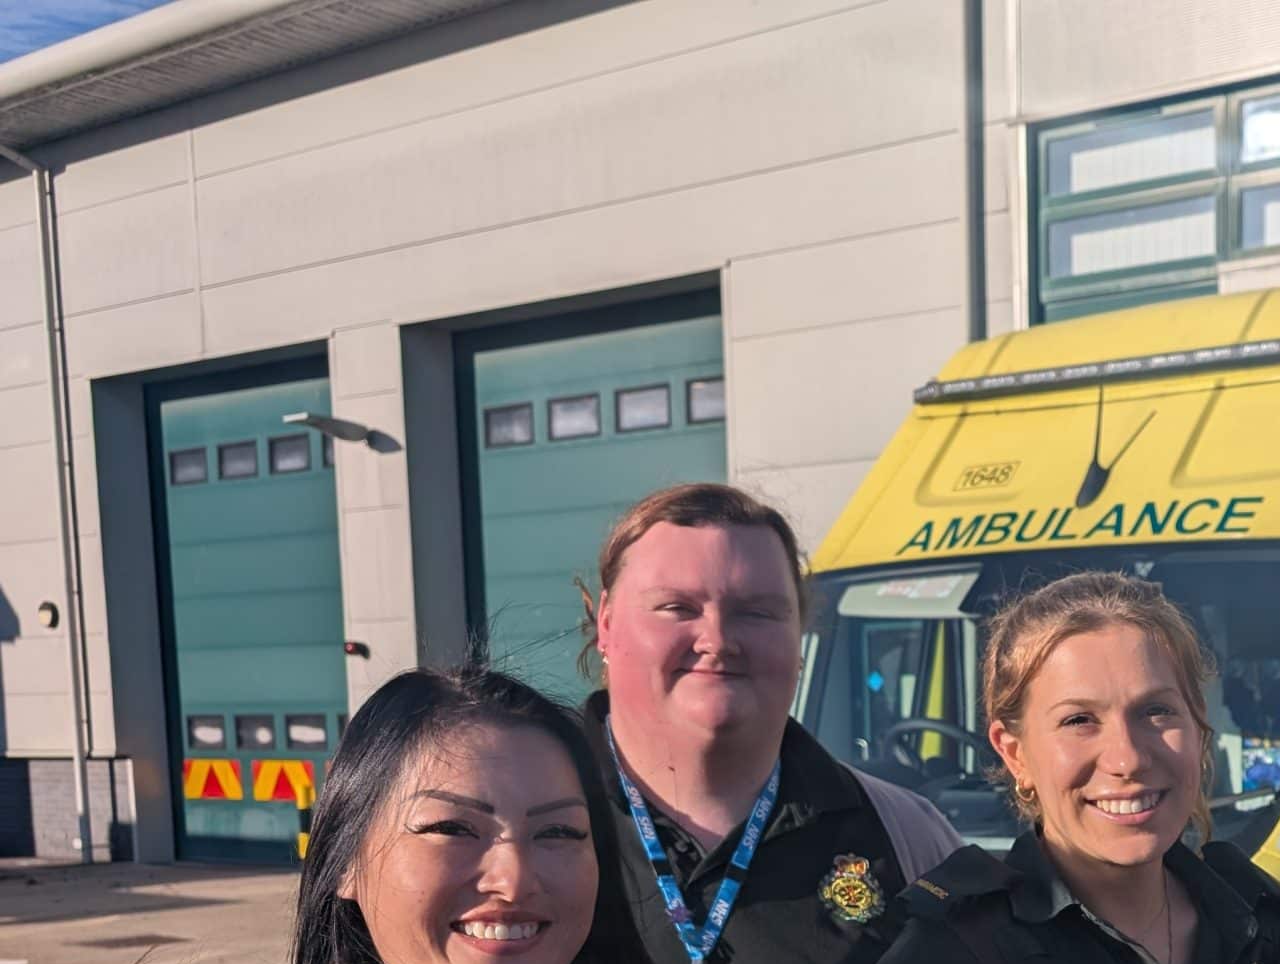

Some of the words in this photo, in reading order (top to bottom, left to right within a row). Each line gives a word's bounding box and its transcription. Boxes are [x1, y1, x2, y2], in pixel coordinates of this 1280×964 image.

[961, 464, 1013, 487] 1648
[896, 496, 1264, 556] AMBULANCE
[755, 796, 772, 821] NHS
[639, 816, 657, 839] NHS
[743, 824, 760, 849] NHS
[711, 899, 730, 926] NHS
